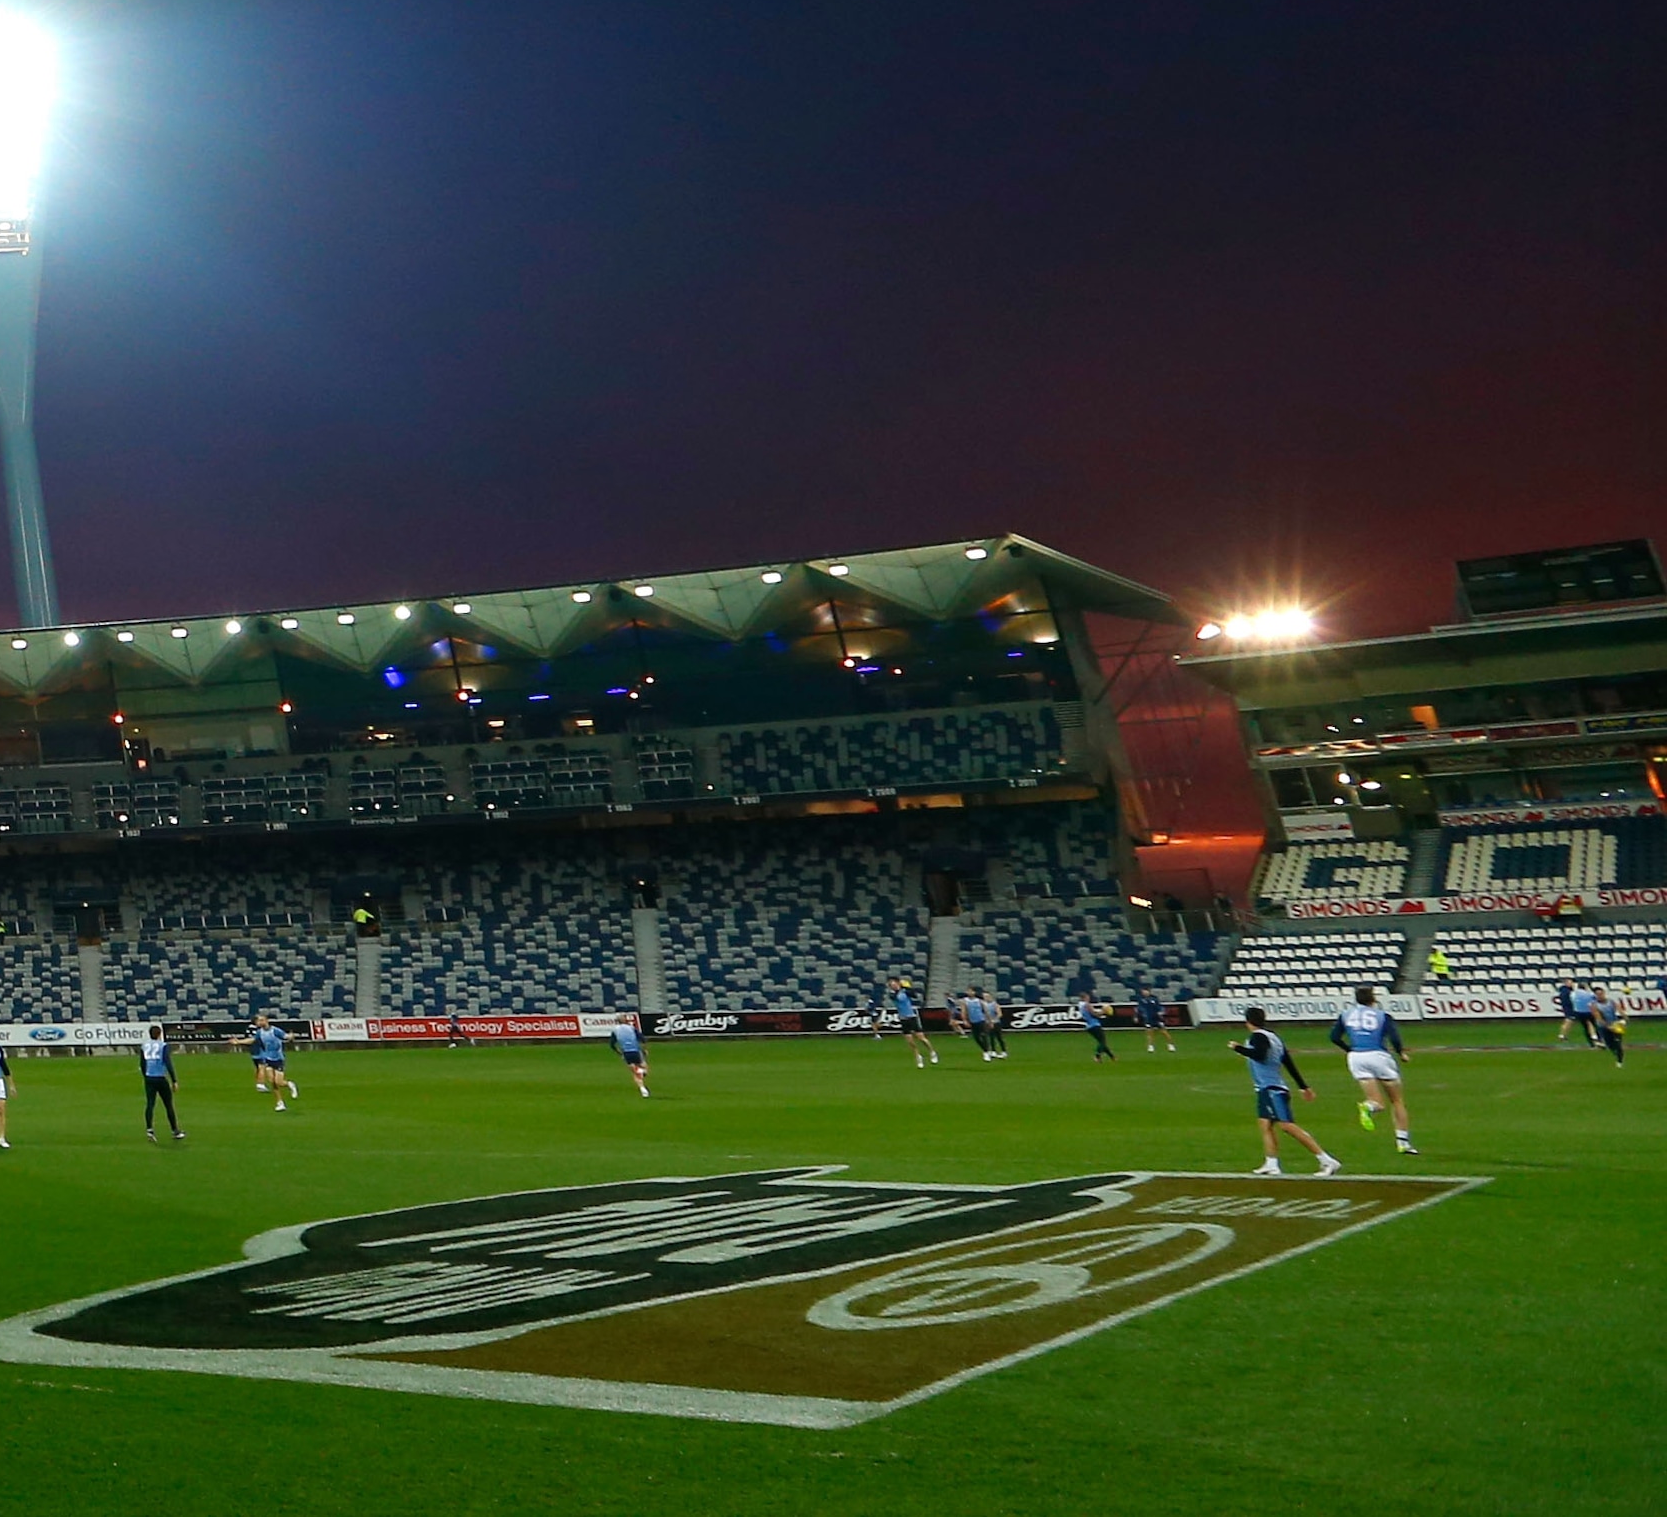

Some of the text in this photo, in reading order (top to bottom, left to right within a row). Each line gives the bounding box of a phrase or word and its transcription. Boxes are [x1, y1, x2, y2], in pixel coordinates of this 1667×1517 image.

[1441, 804, 1630, 826] SIMONDS SIMONDS
[1291, 899, 1392, 918] SIMONDS
[1439, 893, 1543, 913] SIMONDS
[1424, 993, 1666, 1015] SIMONDS SIUM
[369, 1017, 577, 1038] Business Tecnology Specialists
[1346, 1007, 1378, 1031] 46
[74, 1028, 94, 1040] Go
[96, 1027, 144, 1040] Further
[143, 1042, 160, 1059] 22
[1135, 1194, 1384, 1220] TOYOTA
